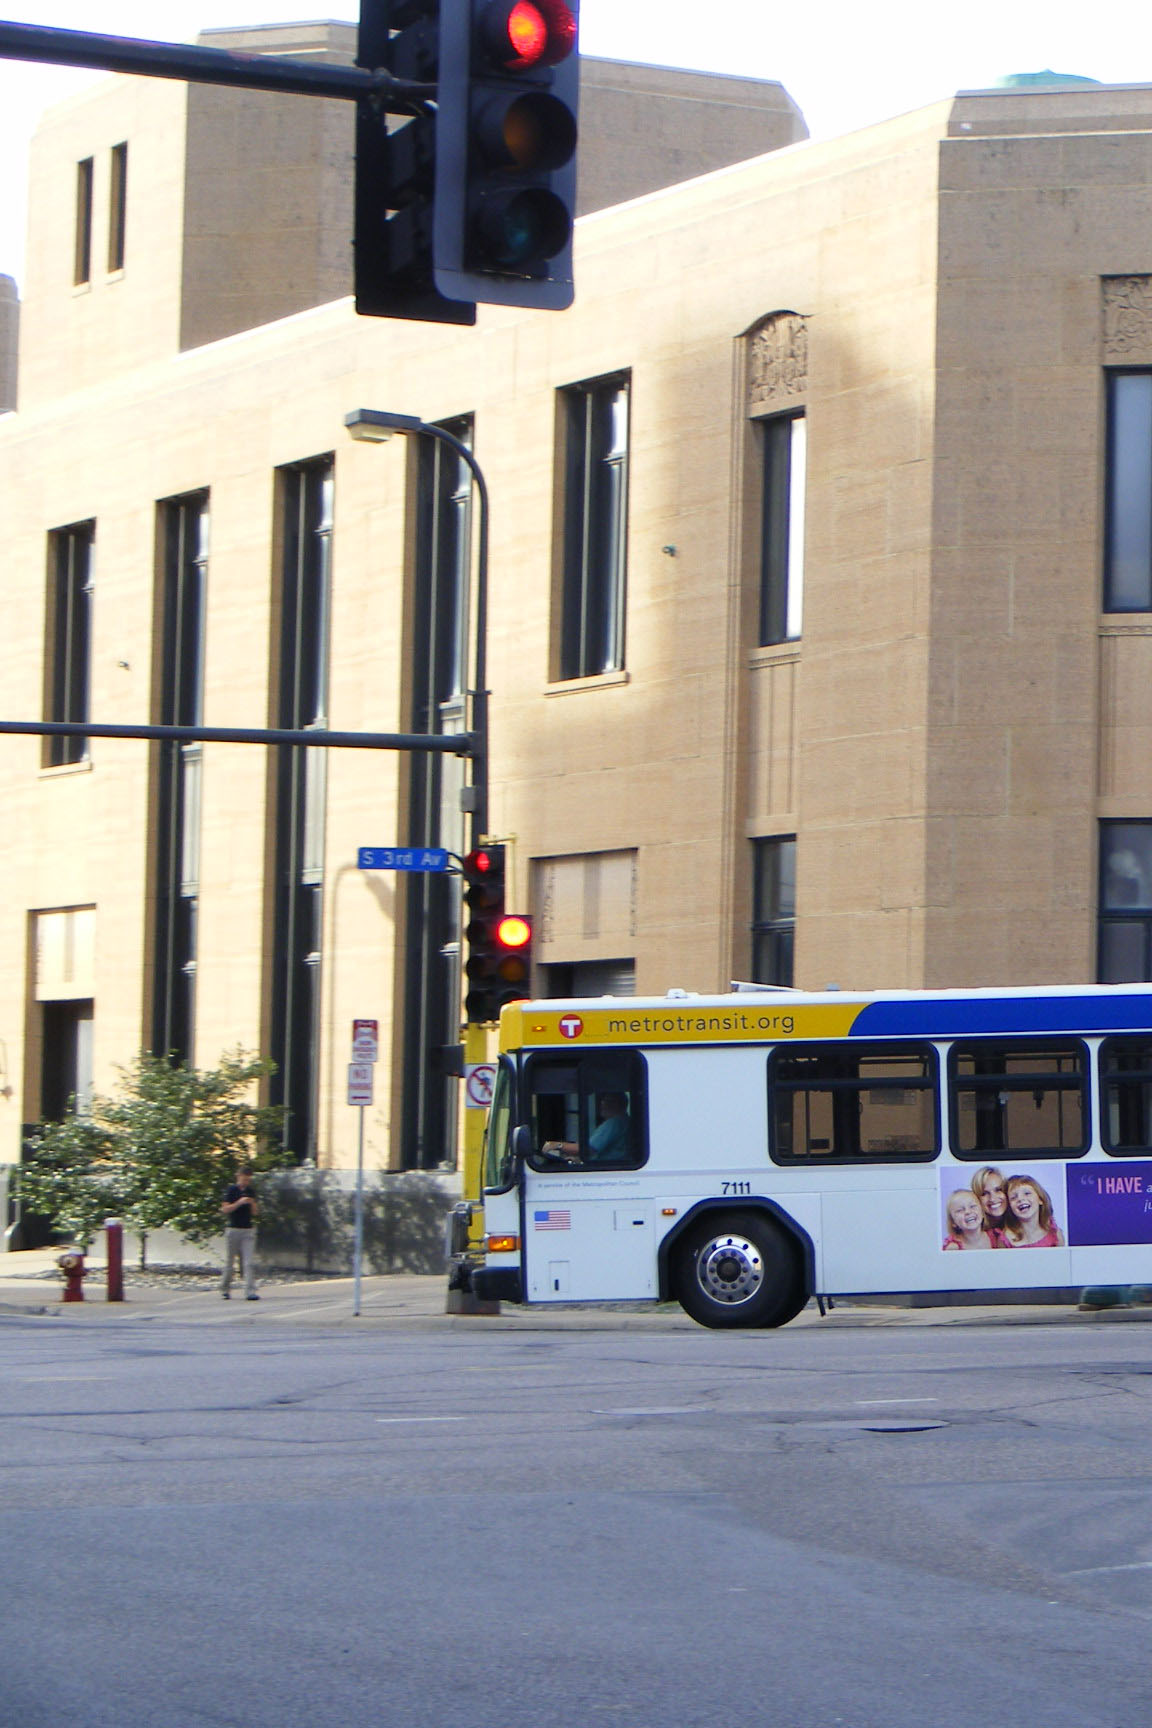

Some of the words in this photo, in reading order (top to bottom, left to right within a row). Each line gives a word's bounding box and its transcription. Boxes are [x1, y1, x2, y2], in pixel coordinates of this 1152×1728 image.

[362, 851, 374, 865] S
[383, 851, 413, 866] 3rd
[420, 852, 442, 866] Av
[561, 1019, 581, 1037] T
[608, 1012, 795, 1034] metrotransit.org
[721, 1182, 750, 1195] 7111
[1105, 1177, 1142, 1194] HAVE
[1146, 1184, 1152, 1193] a
